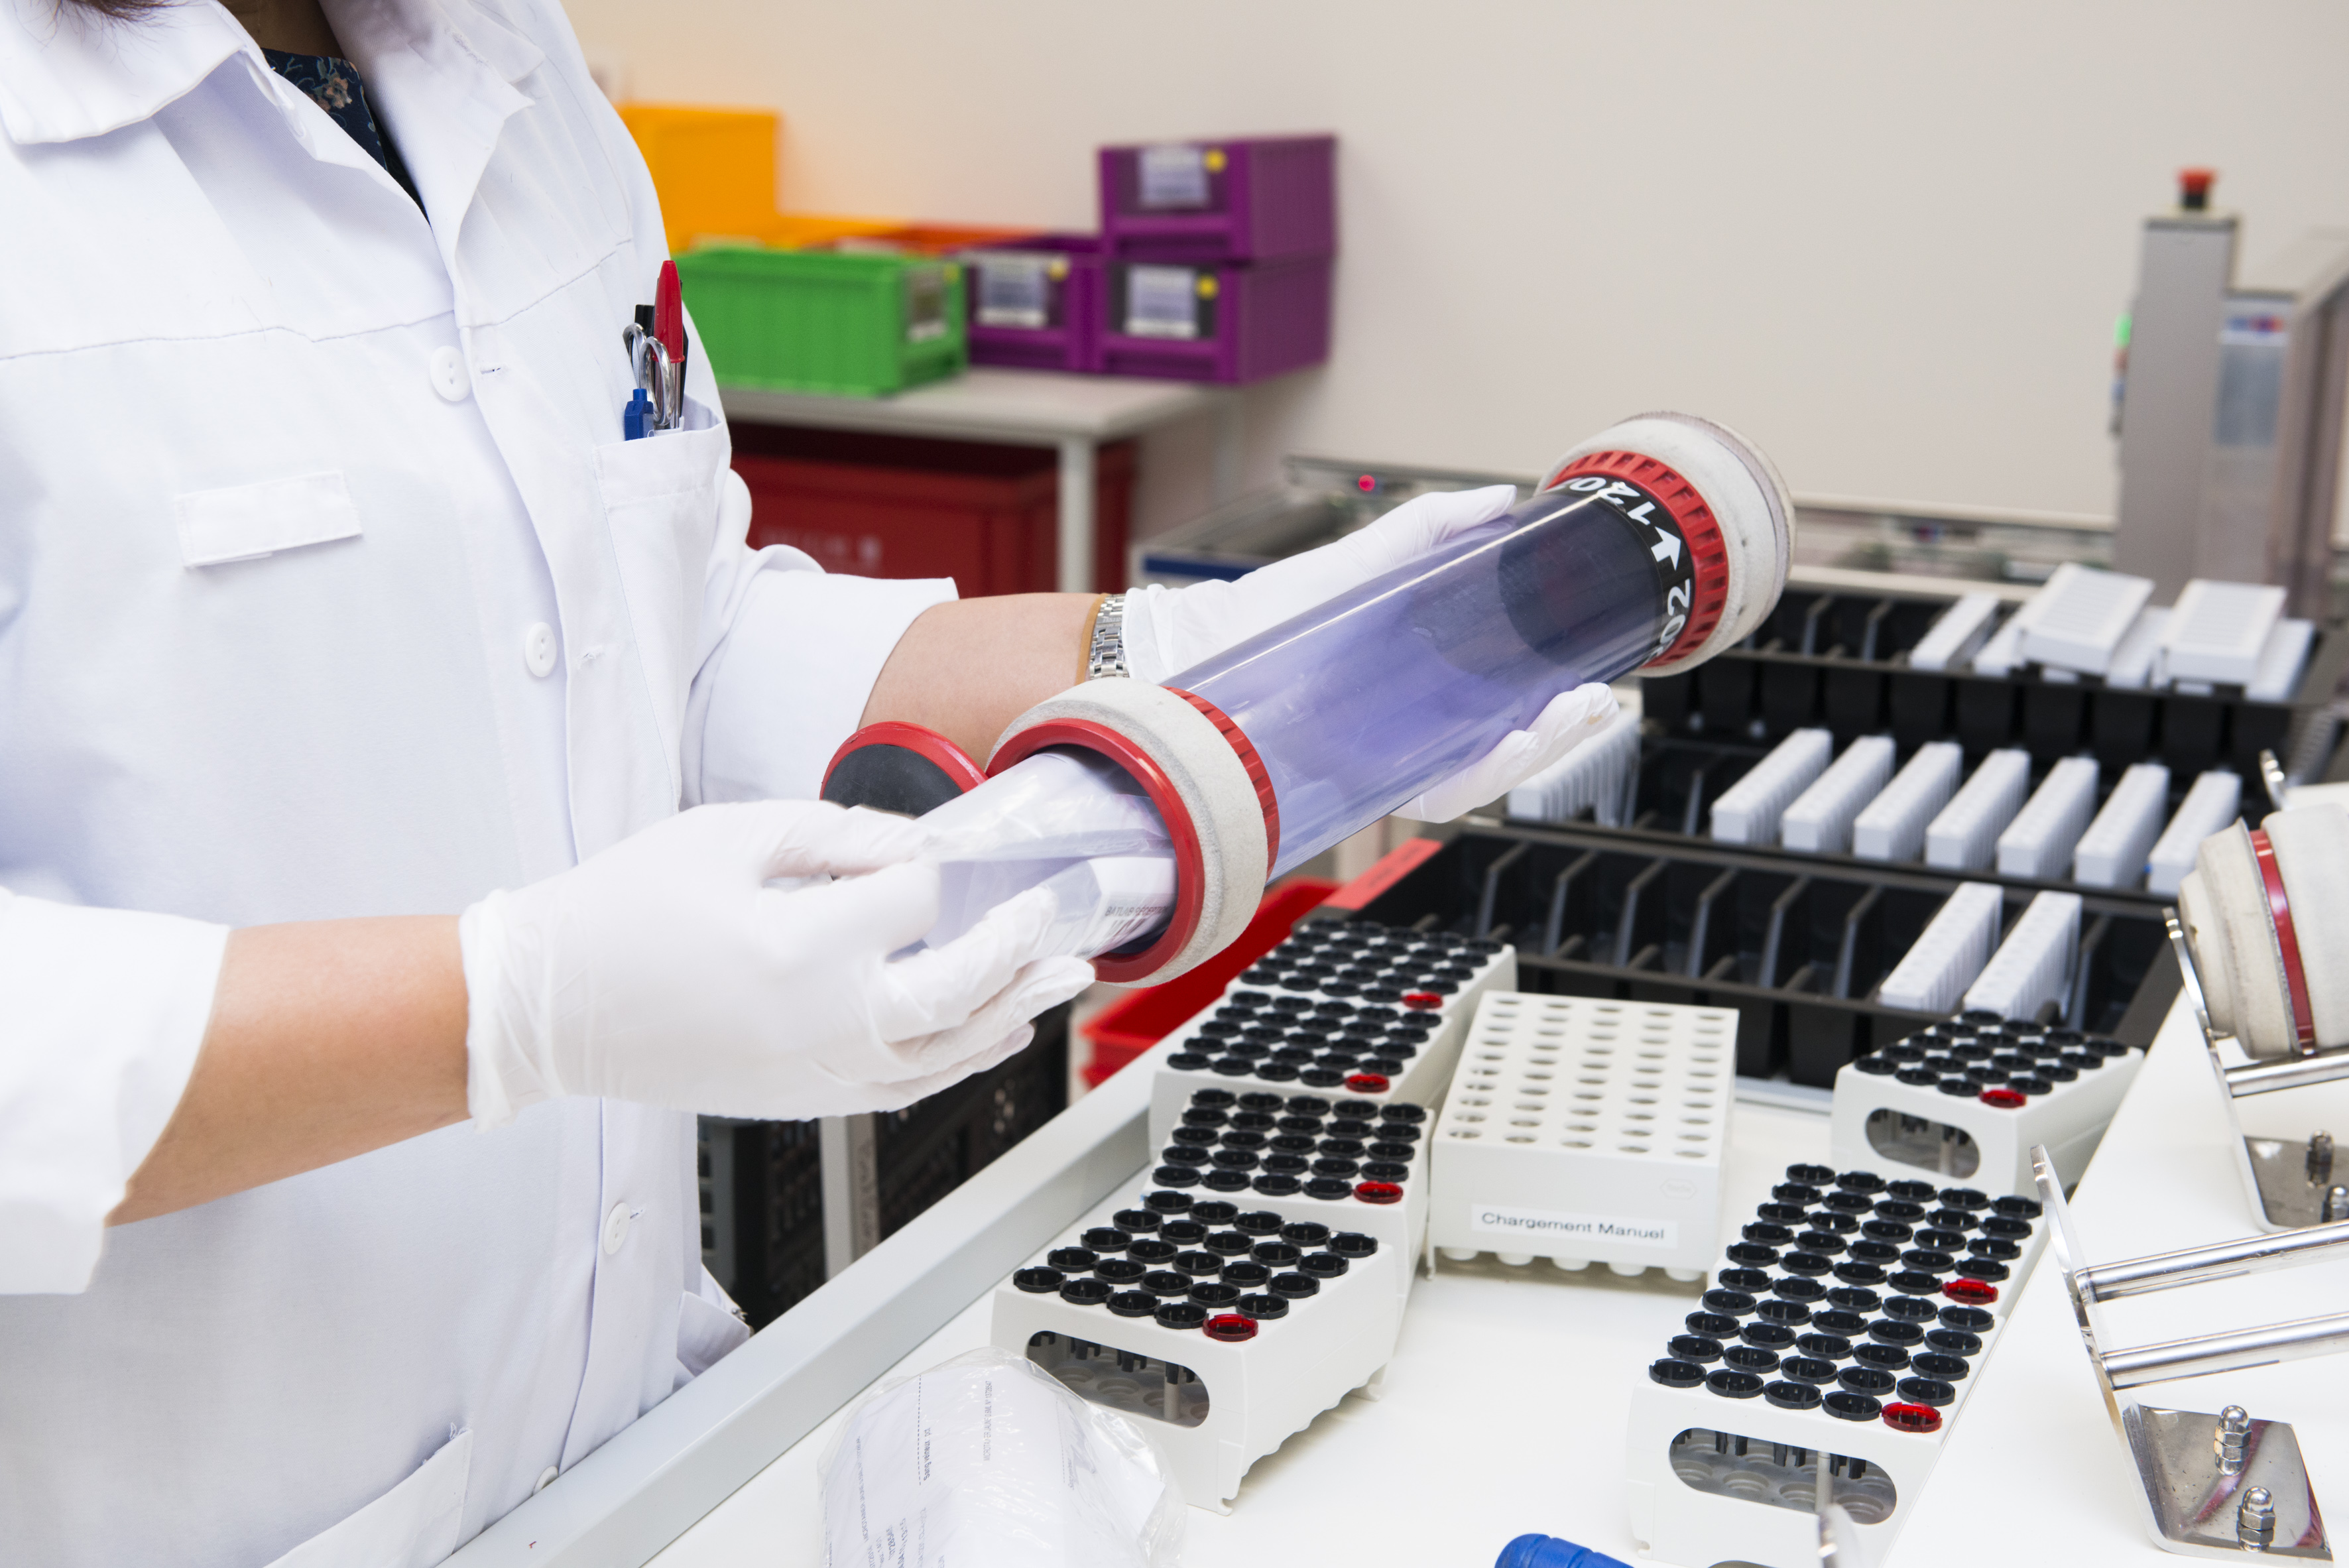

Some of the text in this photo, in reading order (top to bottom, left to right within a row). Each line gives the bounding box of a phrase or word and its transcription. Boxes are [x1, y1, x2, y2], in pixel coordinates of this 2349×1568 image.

[1481, 1211, 1665, 1240] Chargement Manuel
[923, 1461, 932, 1481] Sang
